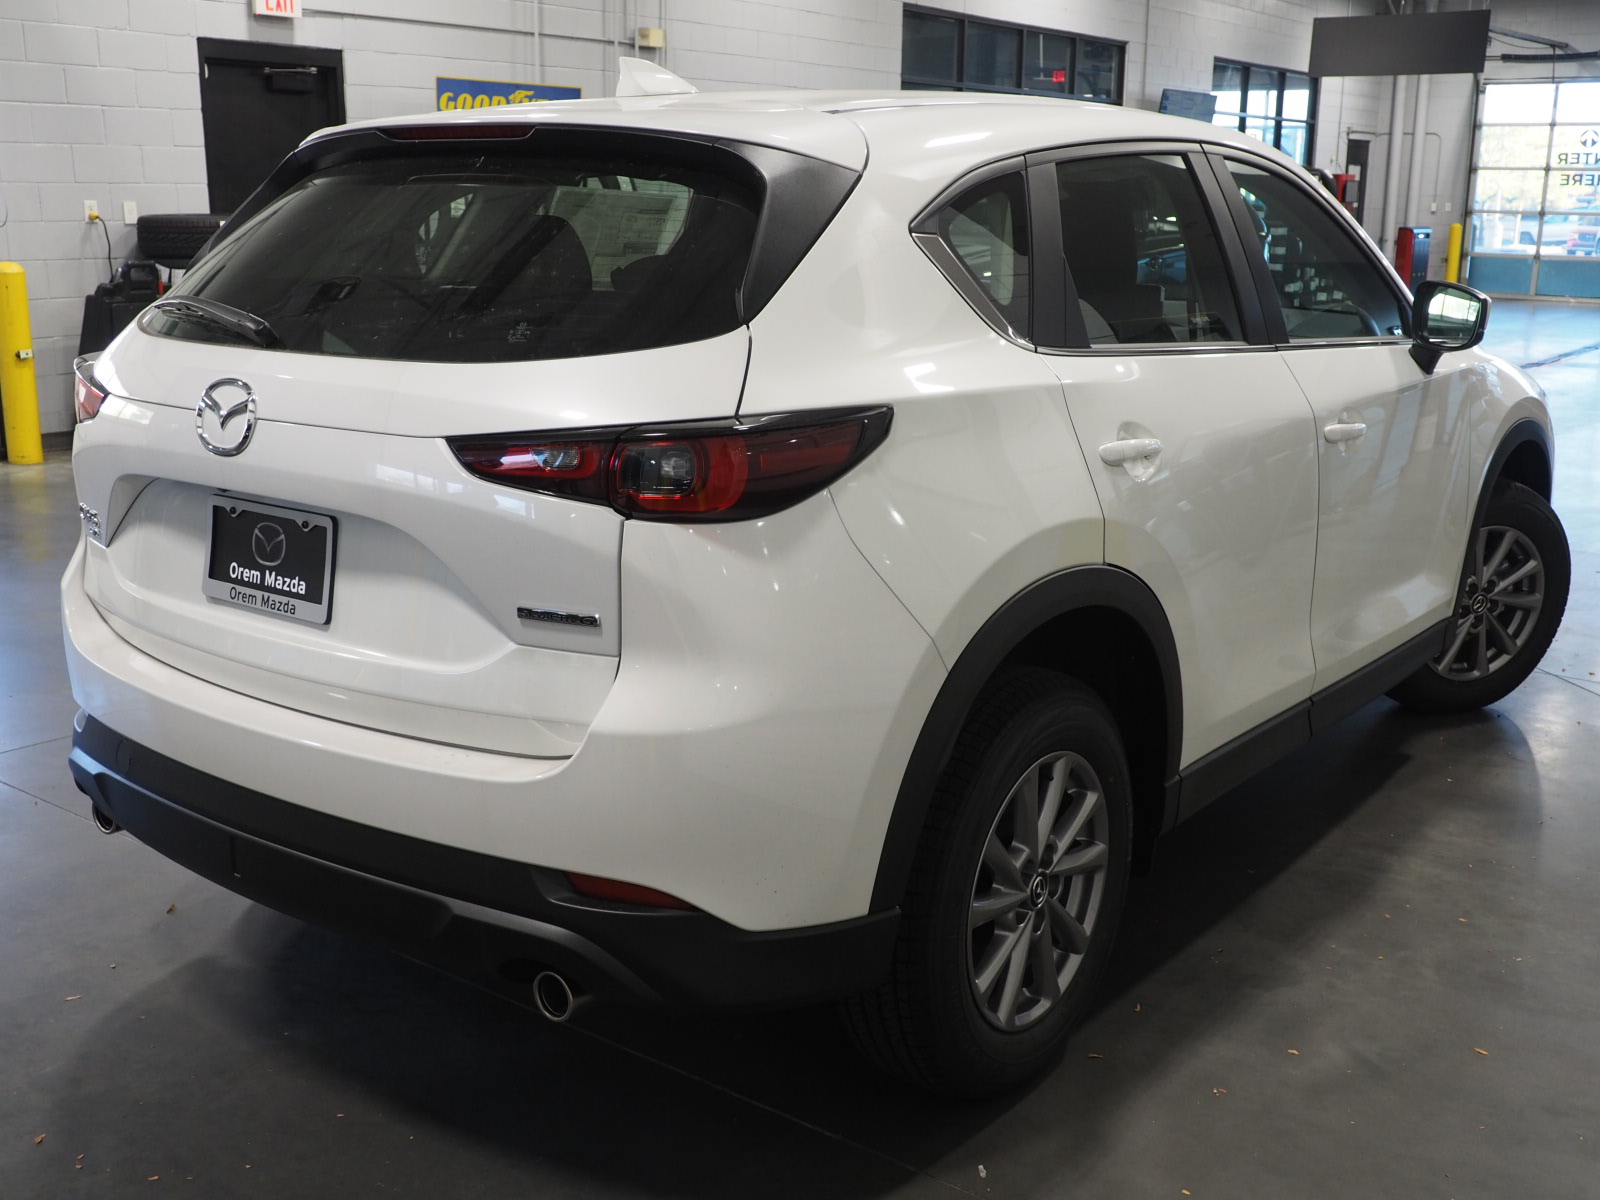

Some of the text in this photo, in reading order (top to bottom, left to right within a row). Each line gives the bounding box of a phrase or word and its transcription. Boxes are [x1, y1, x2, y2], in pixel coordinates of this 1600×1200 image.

[439, 91, 549, 111] GOOD
[229, 561, 307, 595] Orem Mazda
[229, 586, 297, 616] Orem Mazda
